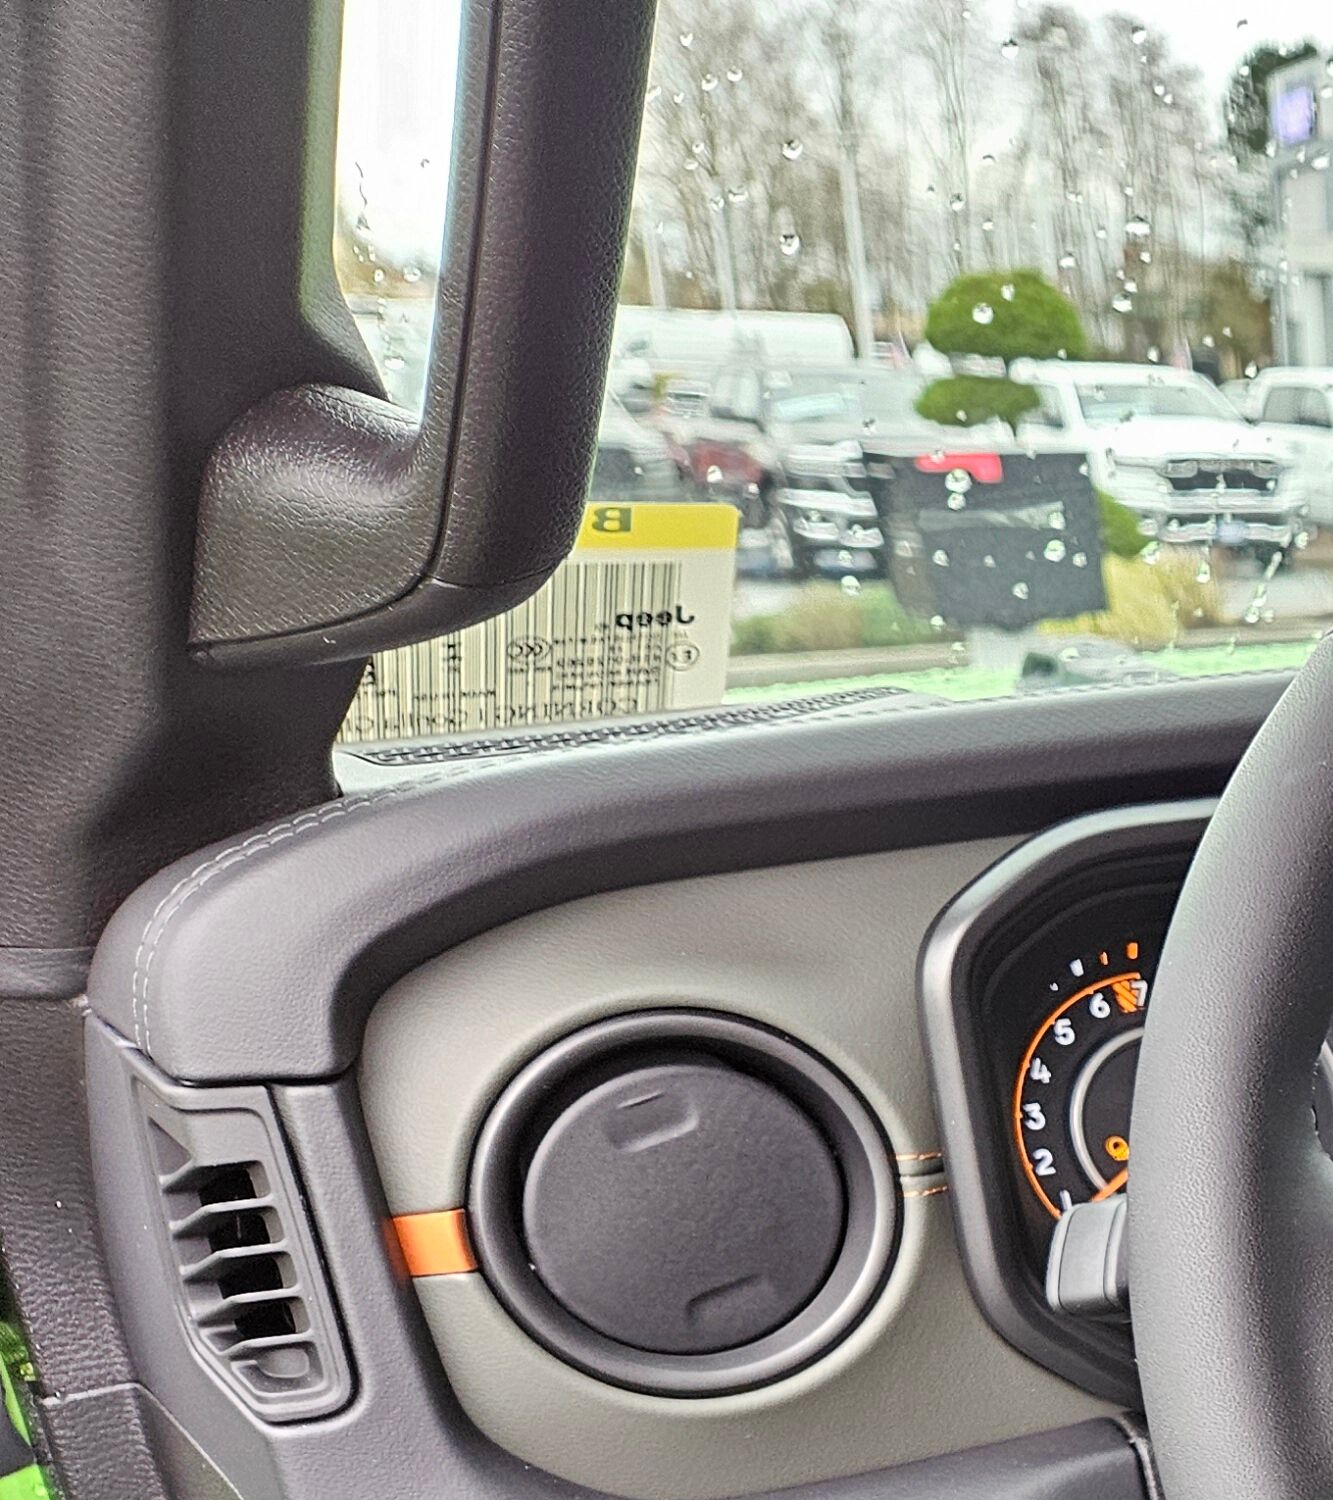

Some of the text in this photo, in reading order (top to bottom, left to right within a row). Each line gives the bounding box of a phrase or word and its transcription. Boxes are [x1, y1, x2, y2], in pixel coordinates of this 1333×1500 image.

[1089, 992, 1110, 1019] 6
[1131, 980, 1148, 1007] 7
[1054, 1018, 1075, 1045] 5
[1030, 1057, 1051, 1084] 4
[1023, 1102, 1046, 1130] 3
[1032, 1148, 1056, 1176] 2
